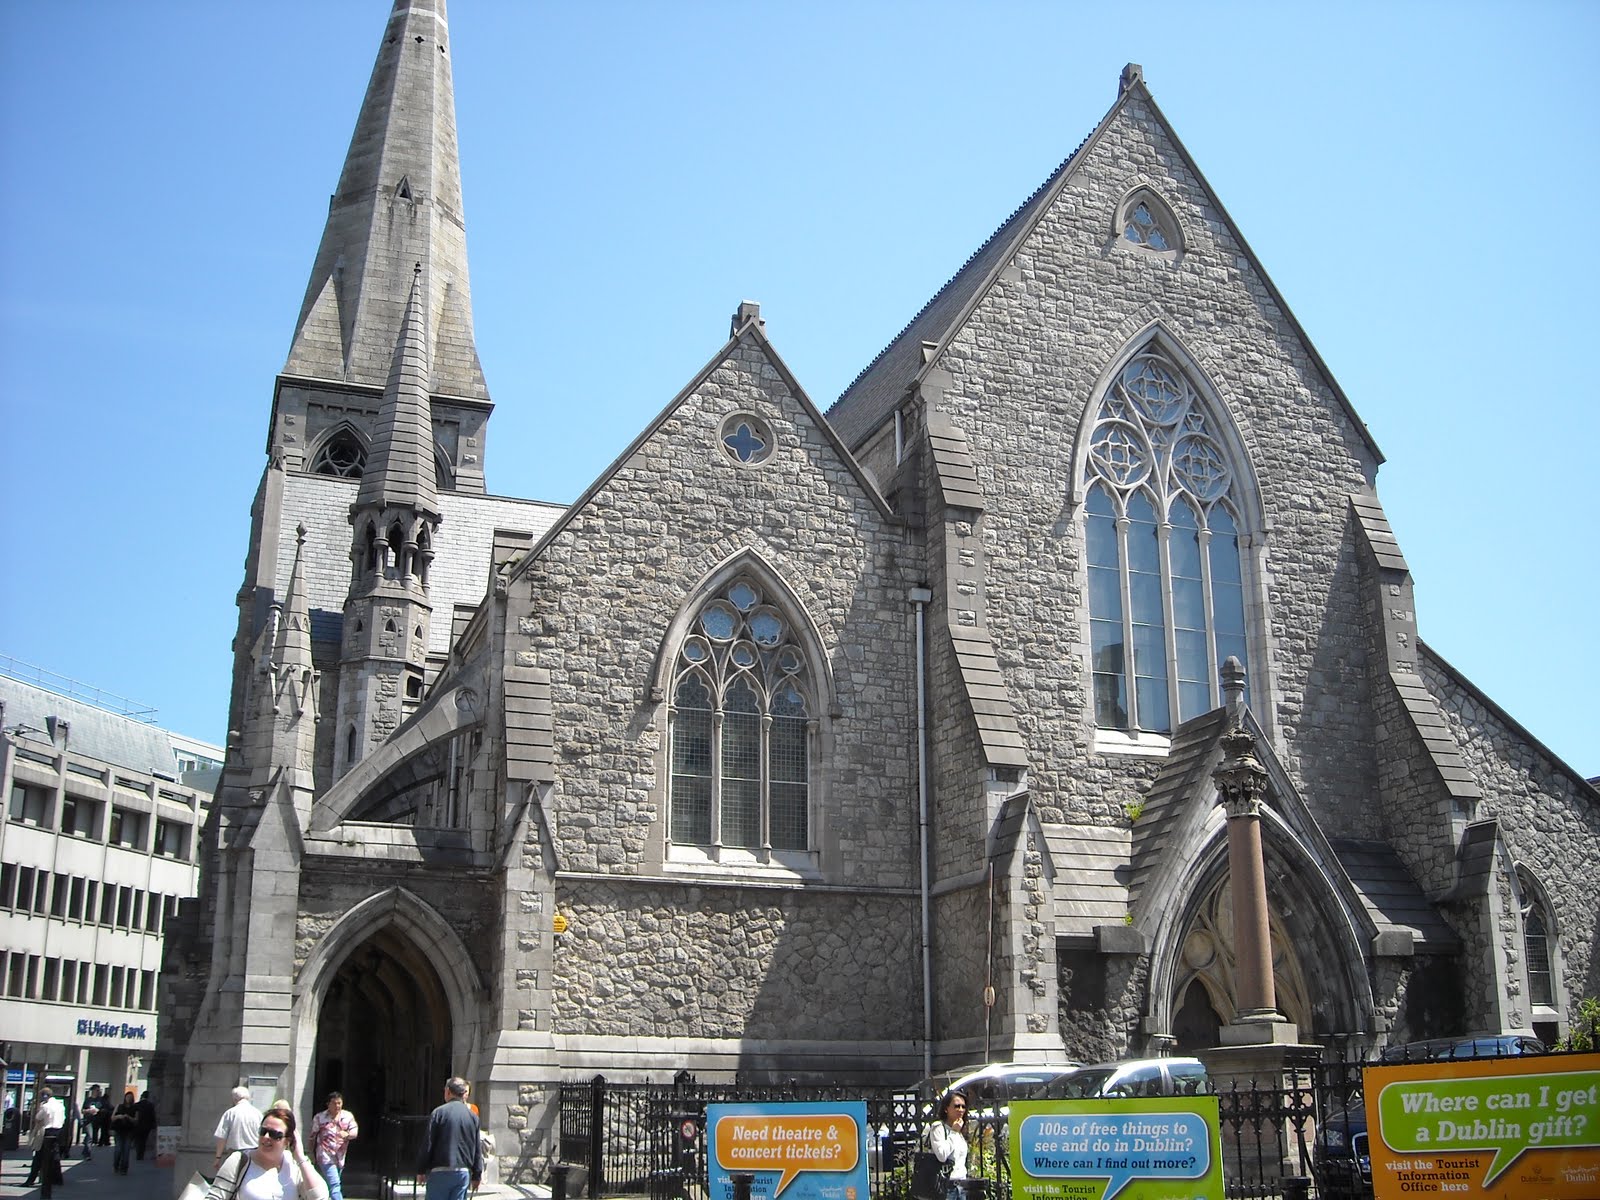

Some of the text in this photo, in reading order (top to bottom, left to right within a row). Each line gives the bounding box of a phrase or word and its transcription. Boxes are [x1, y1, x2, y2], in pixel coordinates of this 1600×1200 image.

[88, 1020, 146, 1040] Ulster Bank
[1401, 1084, 1596, 1113] Where can I get
[733, 1125, 838, 1141] Need theatre &
[1038, 1122, 1188, 1138] 100s of free things to
[1415, 1115, 1587, 1143] a Dublin gift?
[731, 1144, 842, 1159] concert tickets?
[1034, 1138, 1193, 1152] see and do in Dublin?
[1034, 1157, 1196, 1169] Where can I find out more?
[1385, 1158, 1480, 1170] visit the Tourist
[717, 1175, 733, 1184] visi
[1397, 1170, 1470, 1181] Information
[1566, 1173, 1596, 1182] Dublin
[1022, 1184, 1096, 1194] visit the Tourist
[1400, 1181, 1469, 1192] Office here
